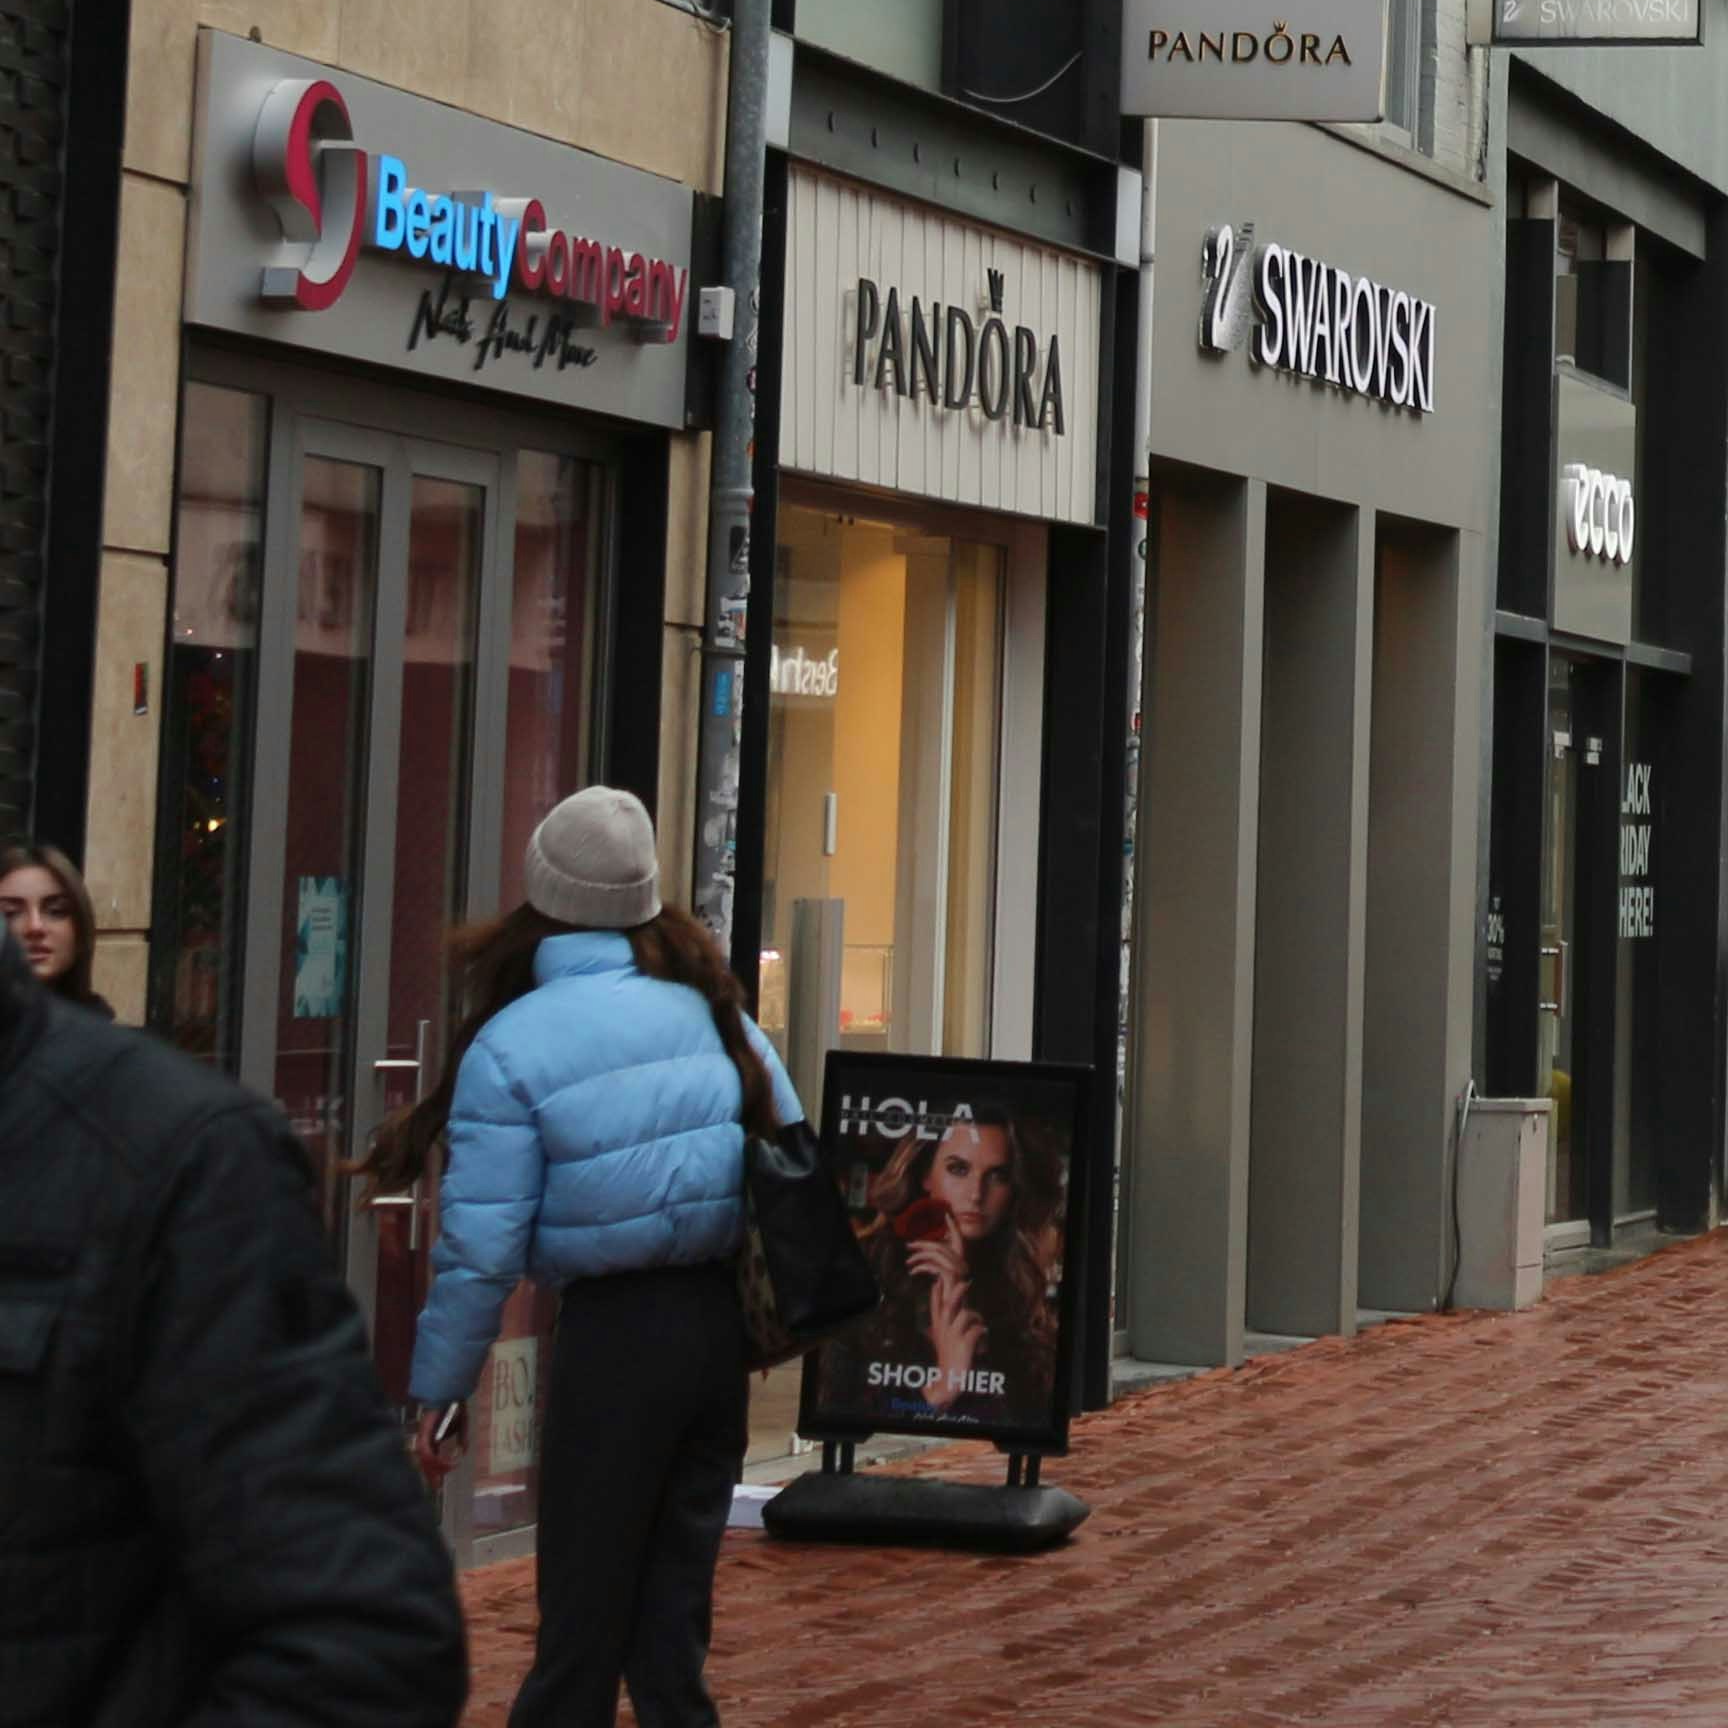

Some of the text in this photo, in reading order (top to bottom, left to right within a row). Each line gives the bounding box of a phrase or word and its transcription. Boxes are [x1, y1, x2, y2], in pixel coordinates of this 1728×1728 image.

[1540, 0, 1688, 23] SWAROVSKI
[1149, 21, 1352, 67] PANDORA
[376, 154, 687, 345] Beauty Company
[853, 269, 1065, 436] PANDORA
[1257, 243, 1436, 414] SWAROVSKI
[1572, 464, 1634, 564] ecco
[1619, 886, 1653, 938] HERE!
[839, 1095, 981, 1144] HOLA
[867, 1361, 1006, 1395] SHOP HIER
